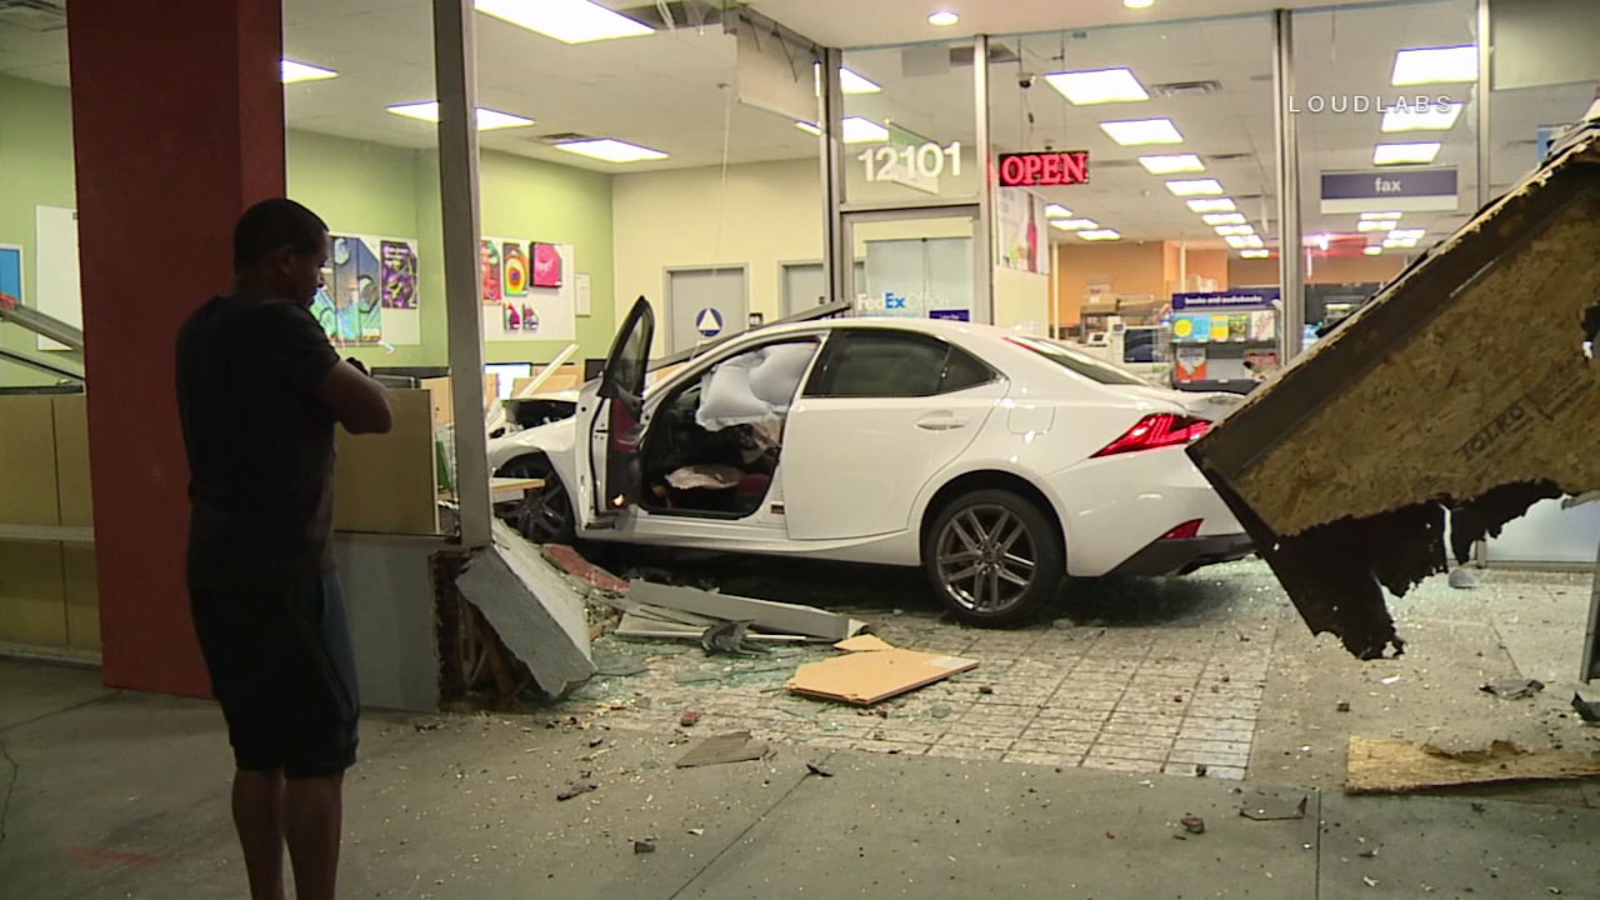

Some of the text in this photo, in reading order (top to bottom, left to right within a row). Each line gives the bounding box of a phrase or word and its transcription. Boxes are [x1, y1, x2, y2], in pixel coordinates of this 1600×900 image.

[857, 141, 961, 182] 12101
[1001, 153, 1088, 185] OPEN
[1374, 177, 1402, 193] fax
[857, 291, 906, 311] FedEx
